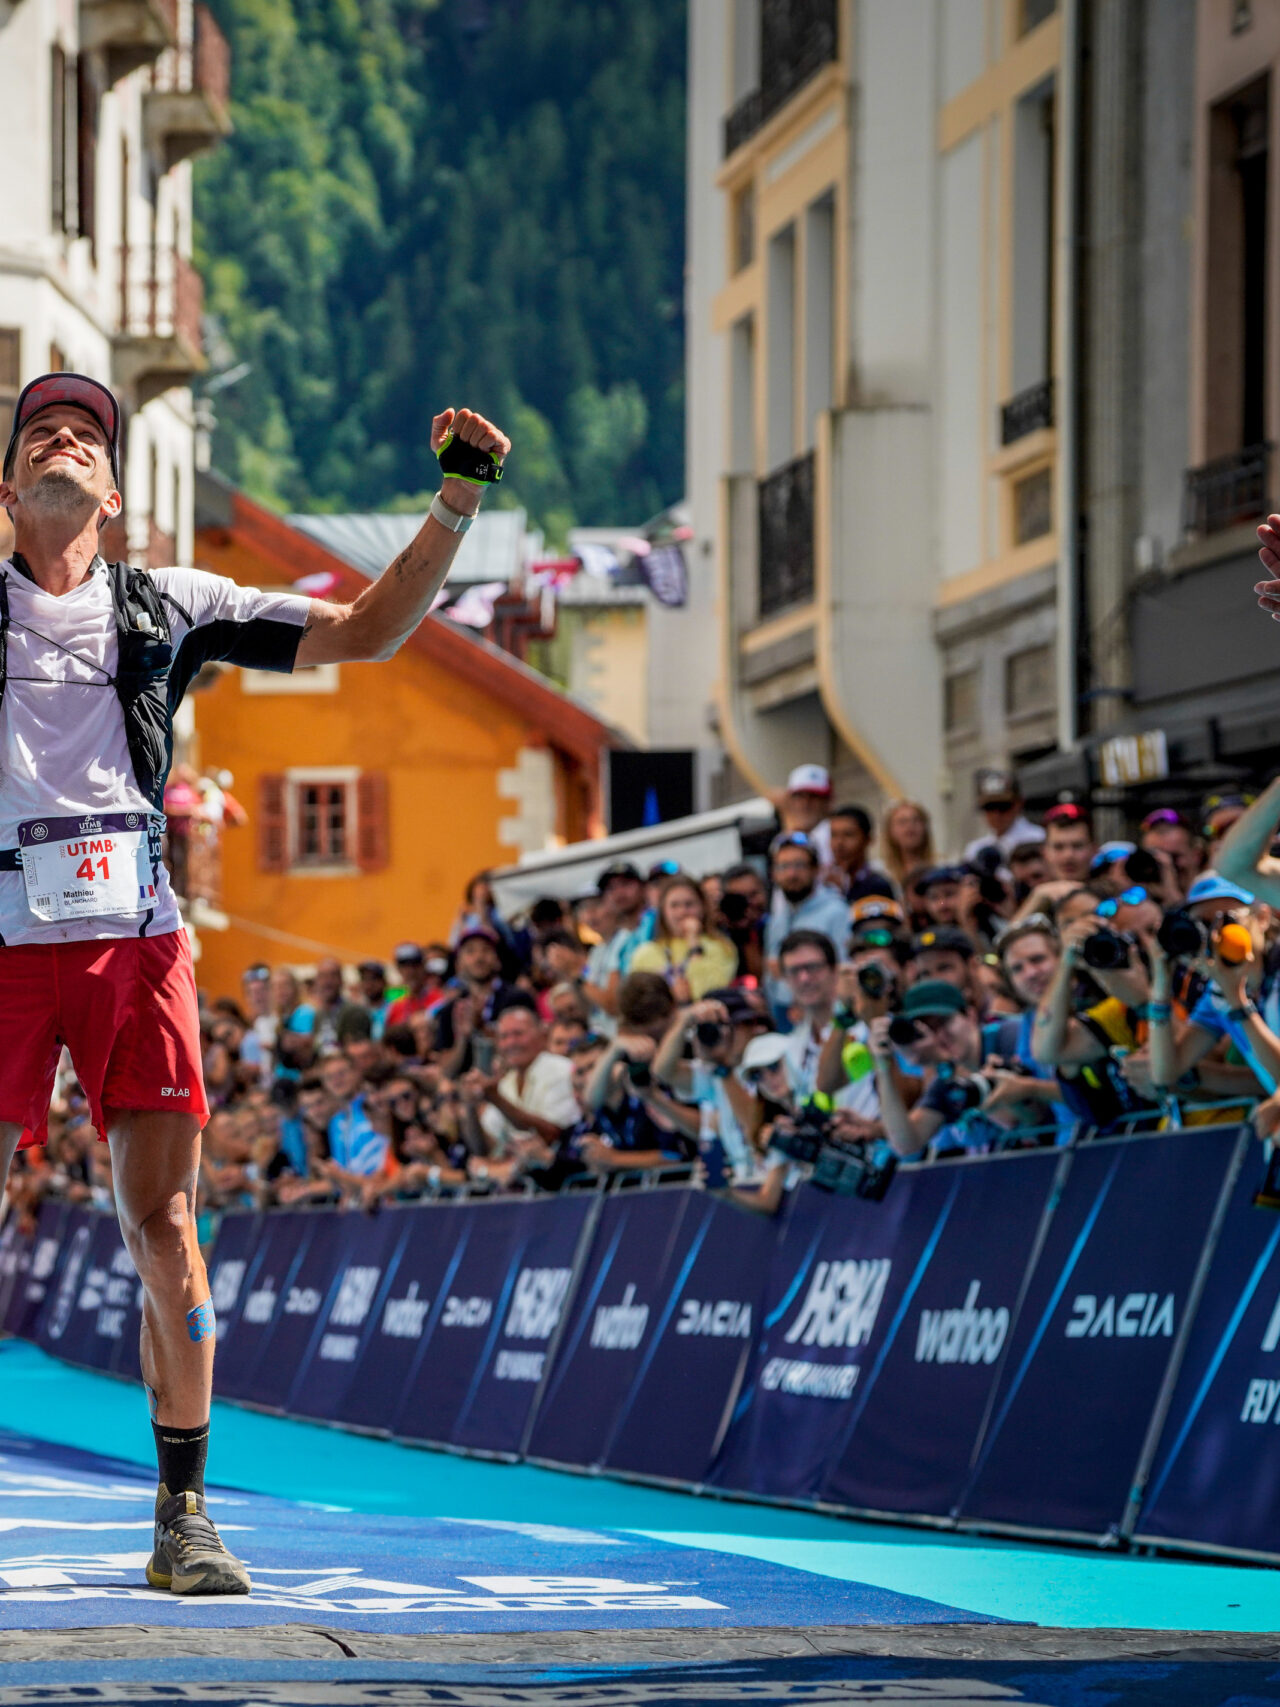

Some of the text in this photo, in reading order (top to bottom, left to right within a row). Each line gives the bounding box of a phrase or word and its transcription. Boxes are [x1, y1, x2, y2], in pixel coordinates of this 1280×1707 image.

[78, 820, 102, 830] UTMB
[67, 839, 114, 856] UTMB
[76, 856, 110, 881] 41
[63, 890, 94, 899] Mathieu
[64, 897, 98, 906] BLANCHARD
[914, 1279, 1010, 1366] wahoo
[1064, 1292, 1175, 1338] DACIA
